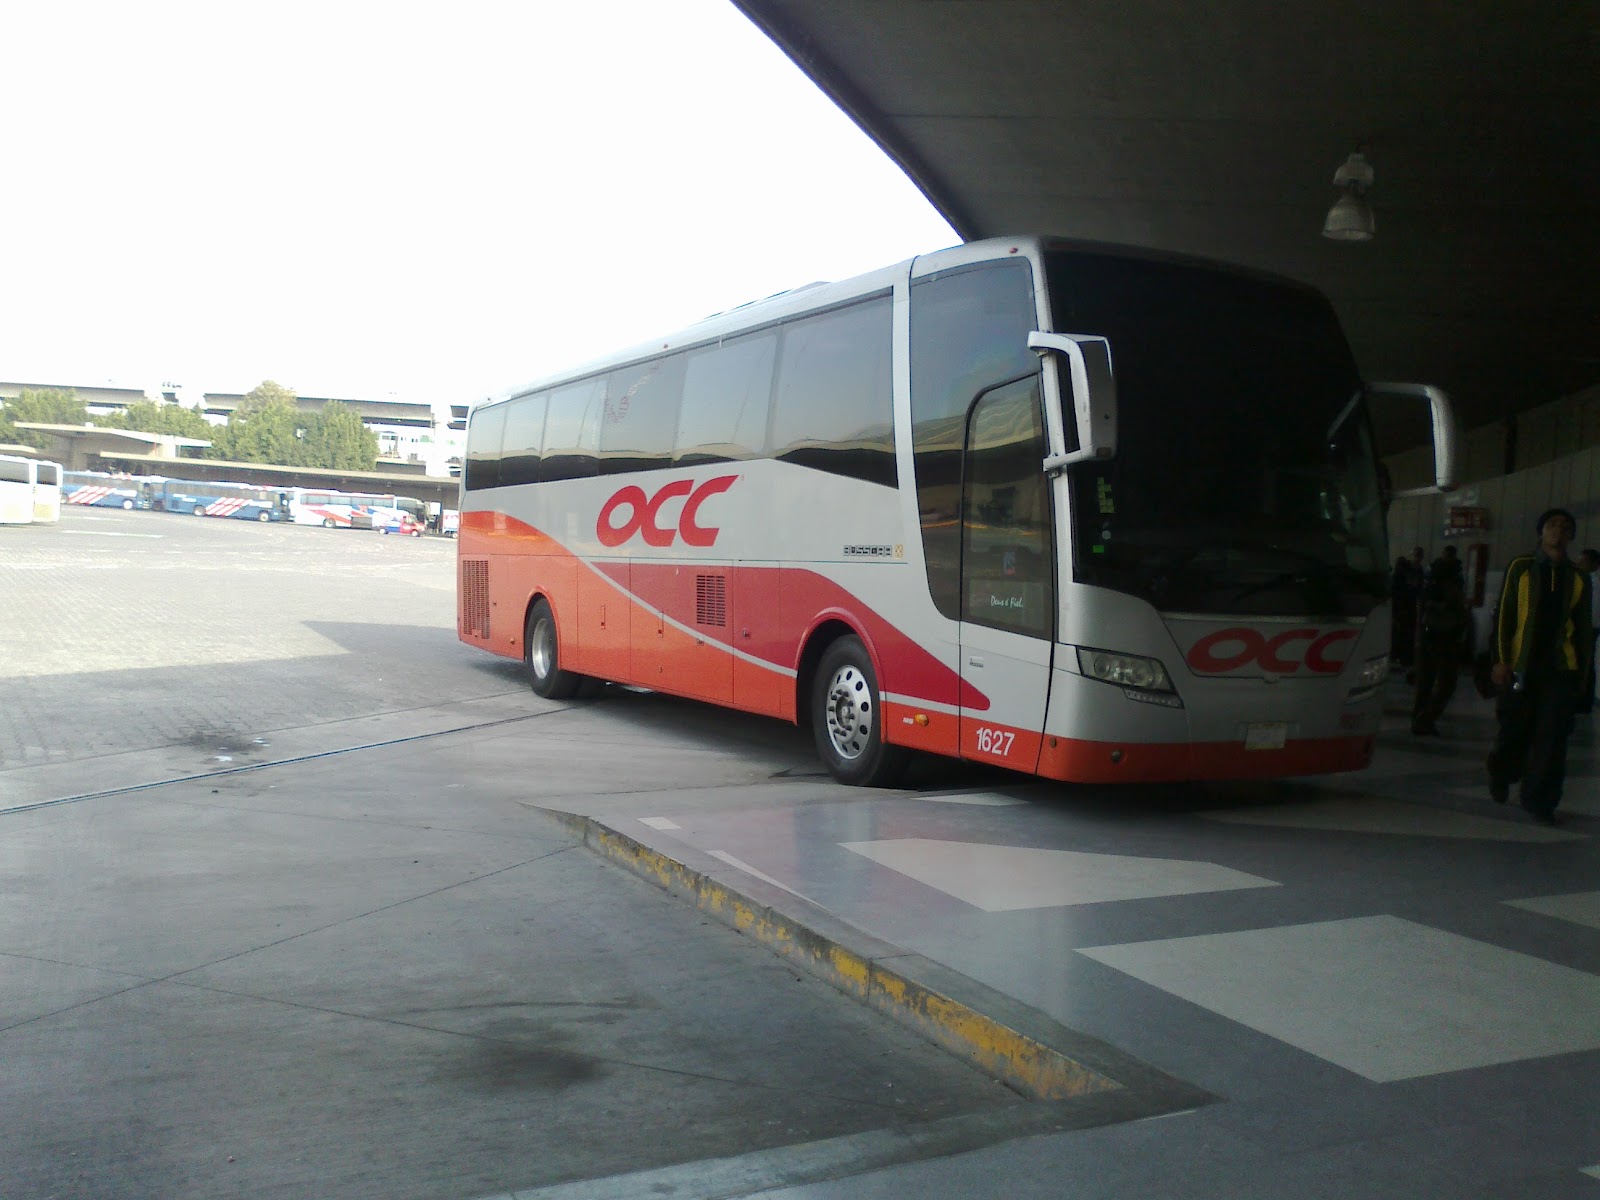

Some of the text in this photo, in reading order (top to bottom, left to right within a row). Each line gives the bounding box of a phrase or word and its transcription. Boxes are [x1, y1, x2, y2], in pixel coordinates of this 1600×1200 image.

[596, 474, 739, 547] OCC
[1187, 627, 1361, 673] OCC
[976, 727, 1015, 757] 1627
